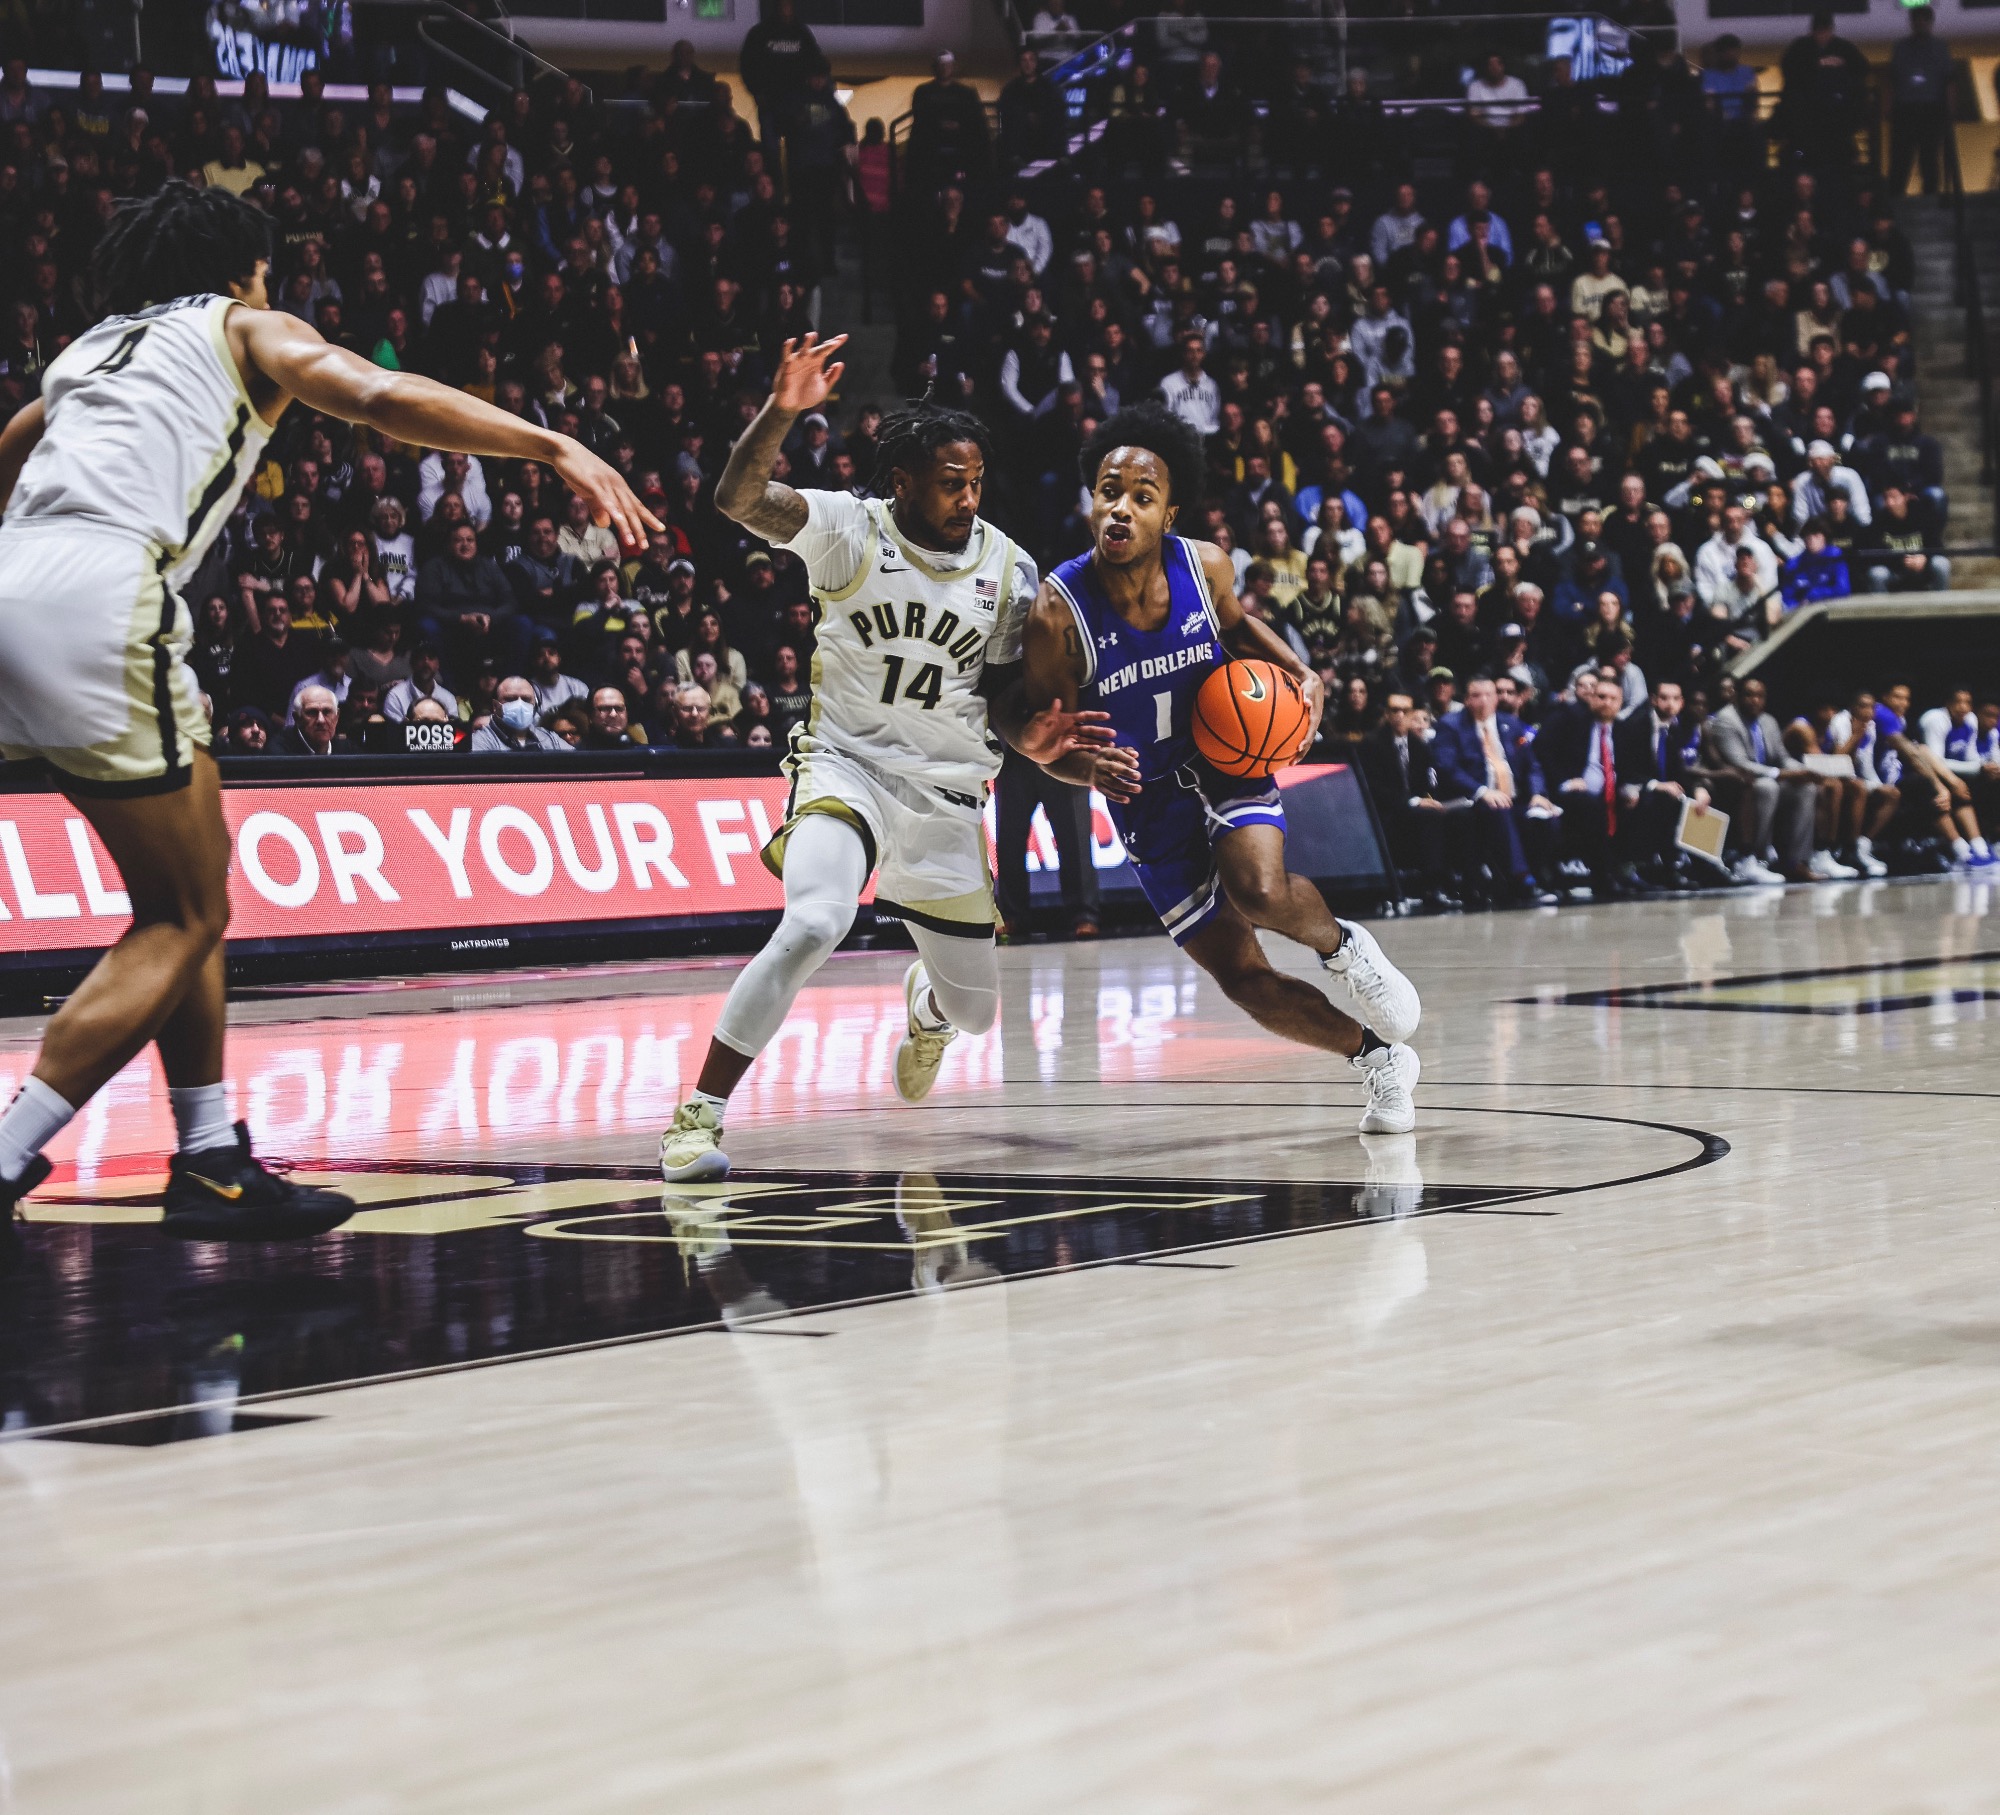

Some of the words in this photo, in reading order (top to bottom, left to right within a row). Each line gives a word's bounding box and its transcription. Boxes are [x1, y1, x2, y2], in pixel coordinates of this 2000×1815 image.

[882, 547, 896, 559] 50
[879, 653, 944, 711] 14
[1098, 662, 1138, 697] NEW
[1141, 642, 1213, 679] ORLEANS
[406, 724, 455, 746] POSS
[1152, 690, 1172, 743] 1
[409, 743, 454, 752] DAKTRONICS
[237, 811, 401, 908] OR
[406, 802, 690, 899] YOUR
[451, 938, 510, 951] DAKTRONICS
